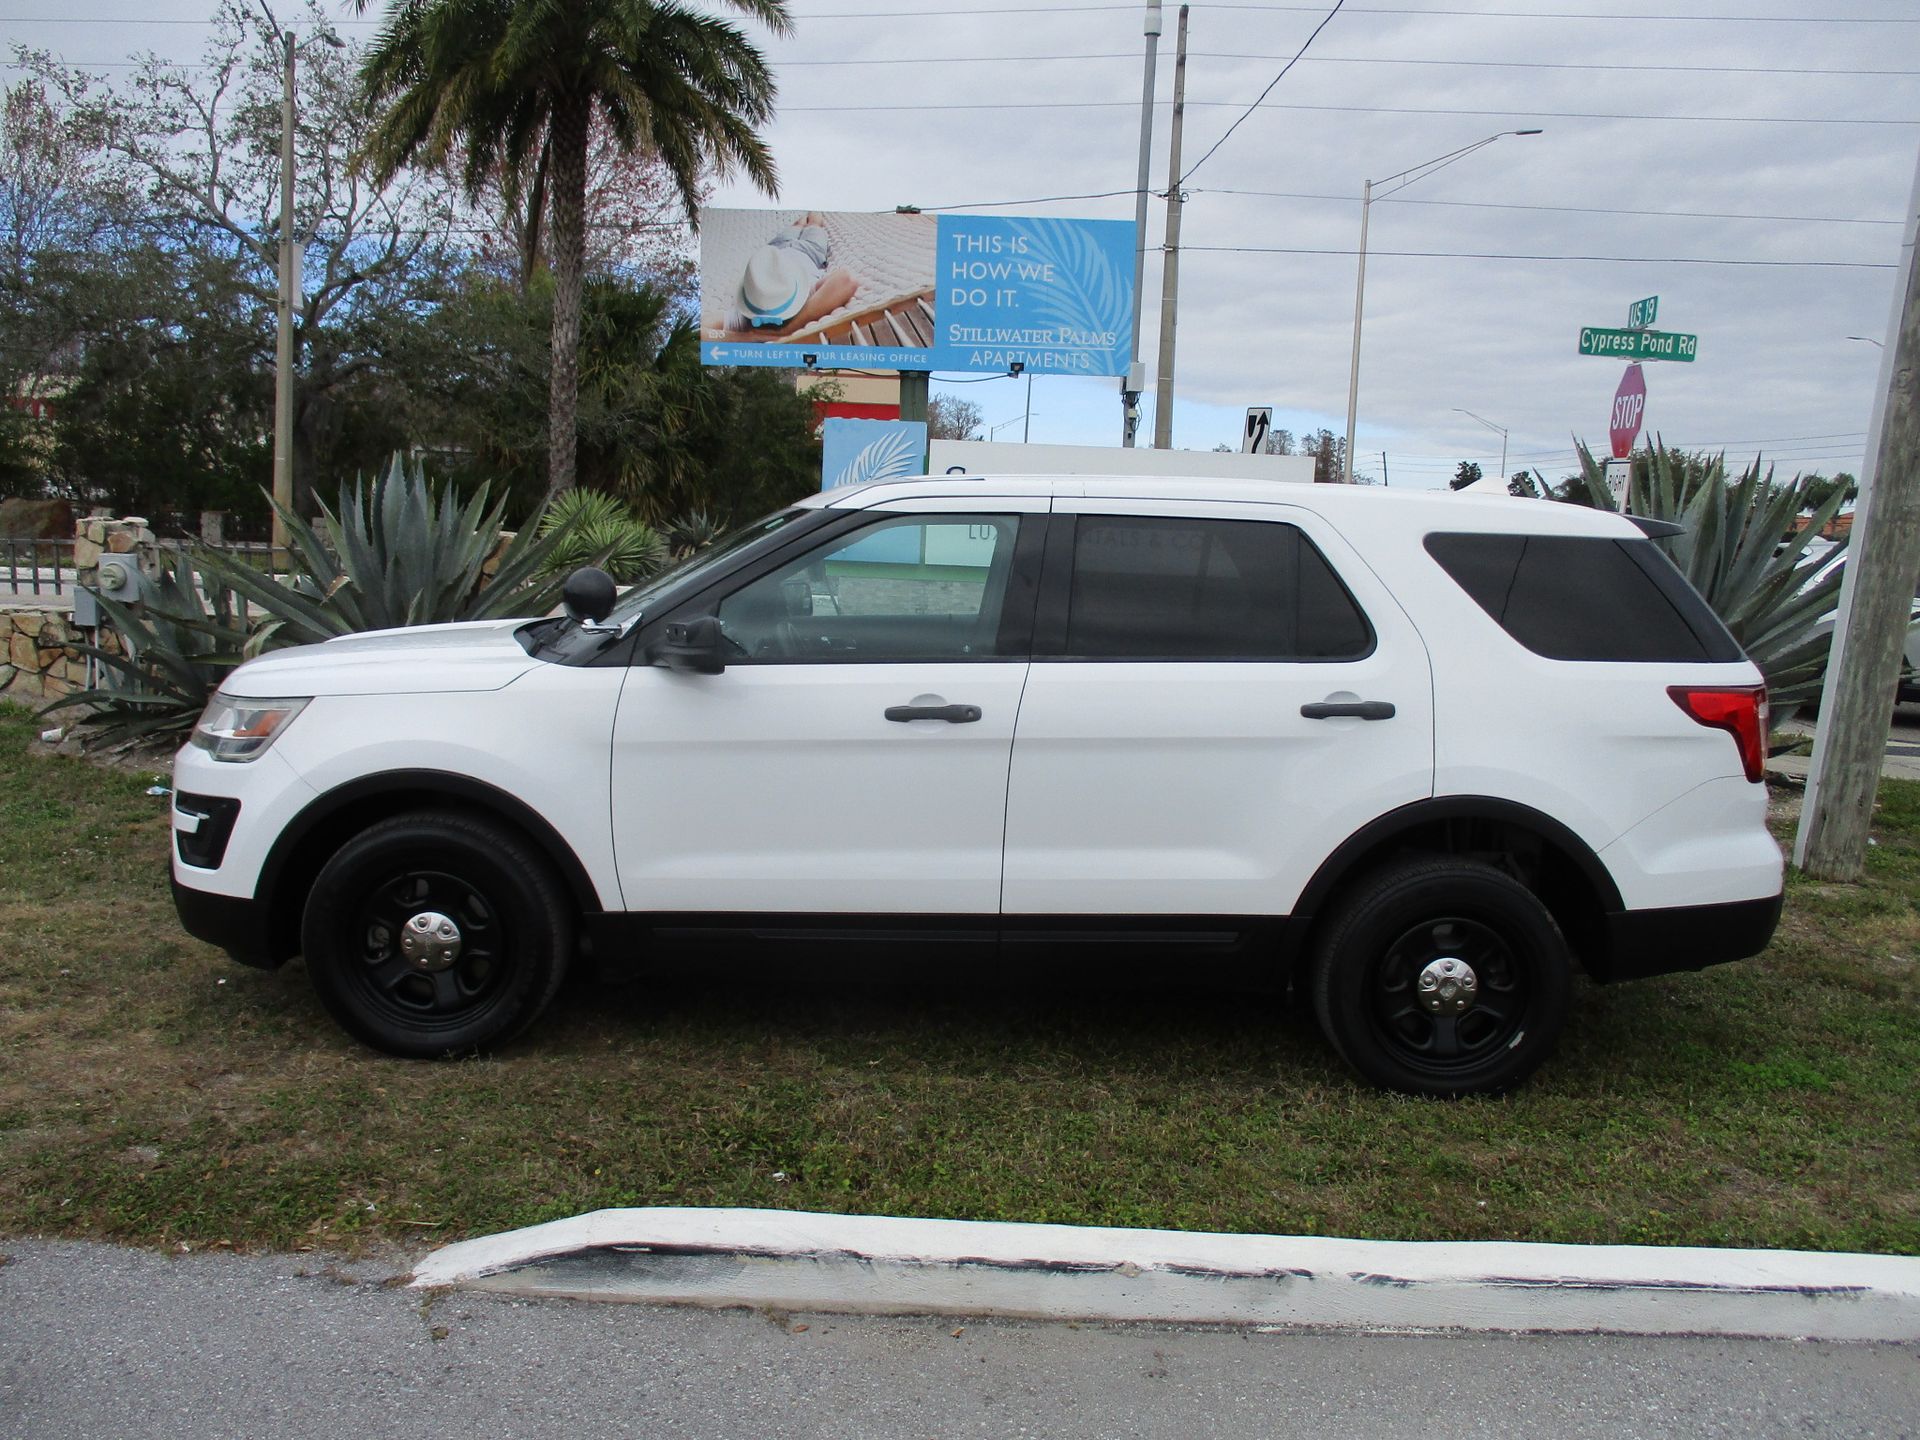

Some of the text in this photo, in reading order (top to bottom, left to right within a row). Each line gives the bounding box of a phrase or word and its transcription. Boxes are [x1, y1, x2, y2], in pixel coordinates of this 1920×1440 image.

[953, 234, 1028, 254] THIS IS
[952, 262, 1055, 282] HOW WE
[952, 288, 1019, 308] DO IT.
[1630, 299, 1655, 327] US 19
[949, 323, 1116, 346] STILLWATER PALMS
[1581, 329, 1695, 355] Cypress Pond Rd
[733, 349, 762, 358] TURN
[767, 350, 790, 359] LEFT
[840, 352, 885, 362] LEASING
[890, 353, 928, 363] OFFICE
[969, 350, 1090, 369] APARTMENTS
[1612, 393, 1643, 430] STOP
